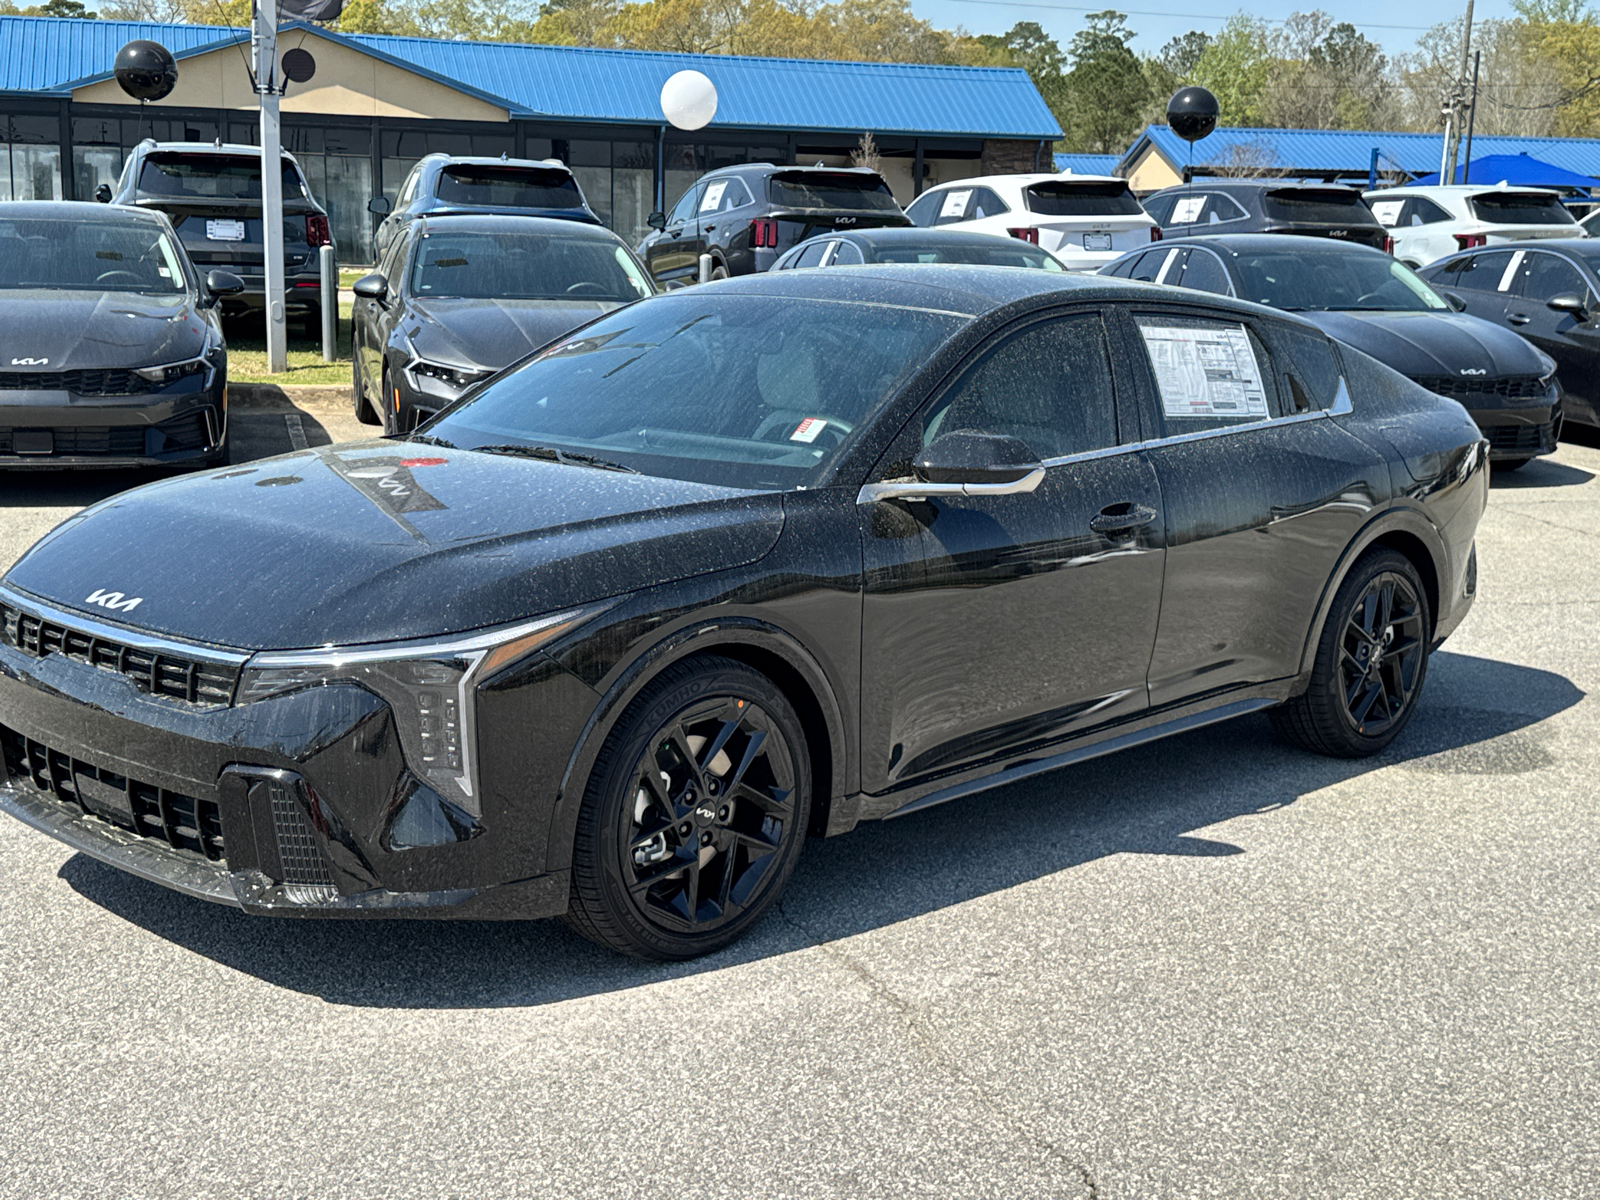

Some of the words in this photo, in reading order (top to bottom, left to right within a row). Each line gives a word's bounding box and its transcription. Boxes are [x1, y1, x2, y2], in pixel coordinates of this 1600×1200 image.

[11, 357, 49, 365] KIA
[85, 588, 143, 613] KIA
[645, 682, 701, 727] KUMHO
